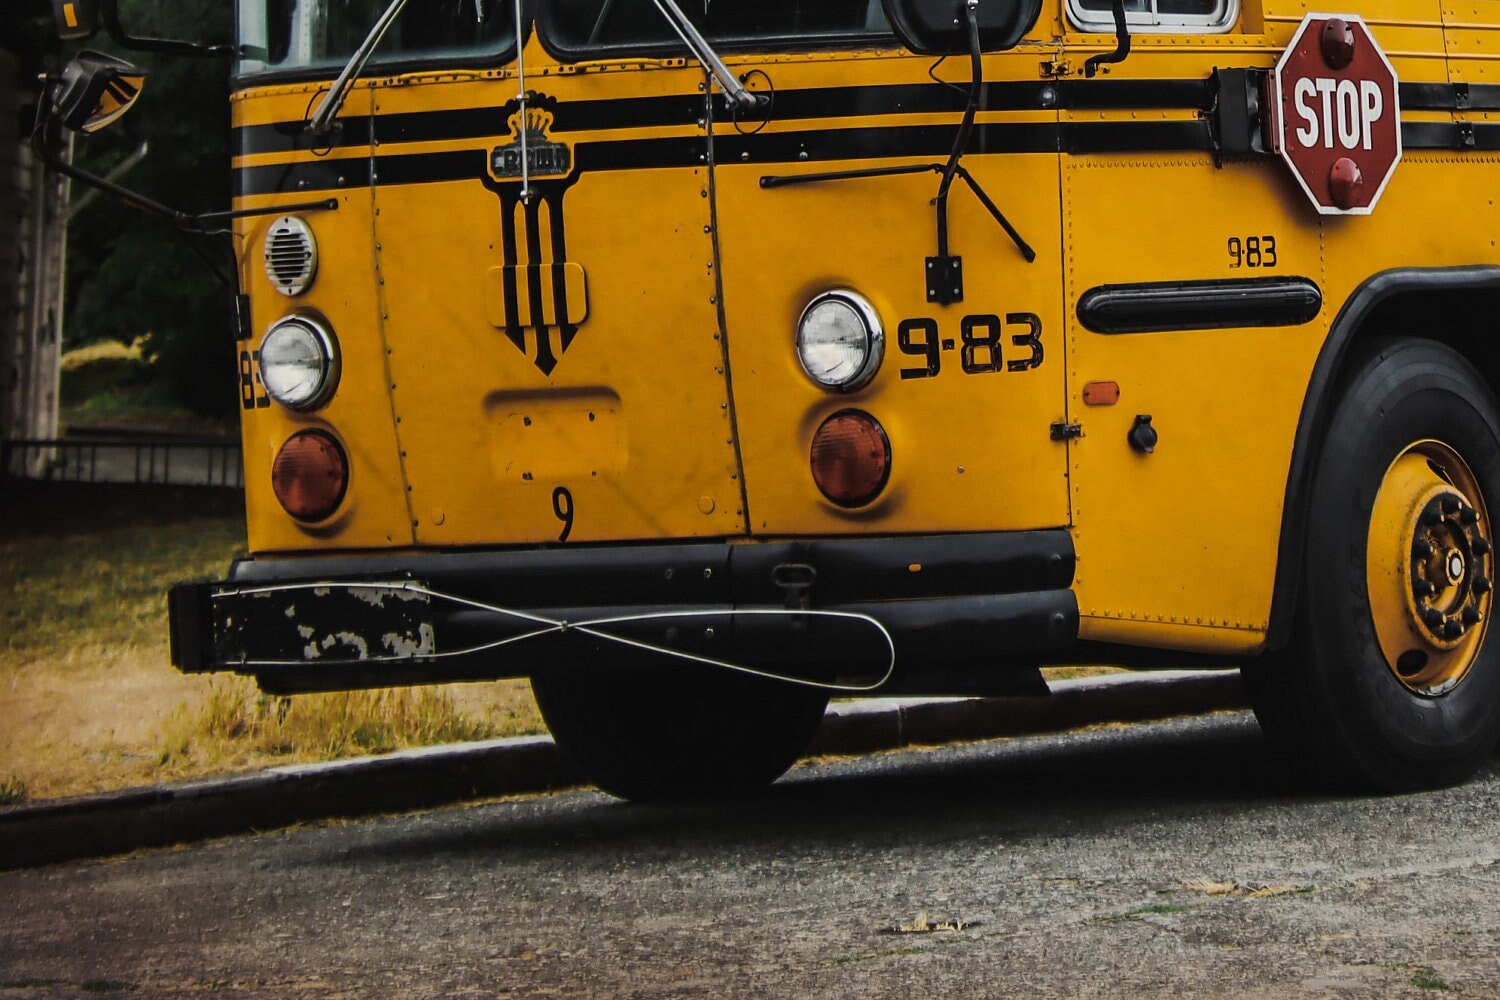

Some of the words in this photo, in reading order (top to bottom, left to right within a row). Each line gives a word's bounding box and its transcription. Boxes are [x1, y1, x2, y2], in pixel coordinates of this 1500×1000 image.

[1294, 76, 1383, 150] STOP
[898, 312, 1044, 379] 9-83
[552, 486, 574, 543] 9
